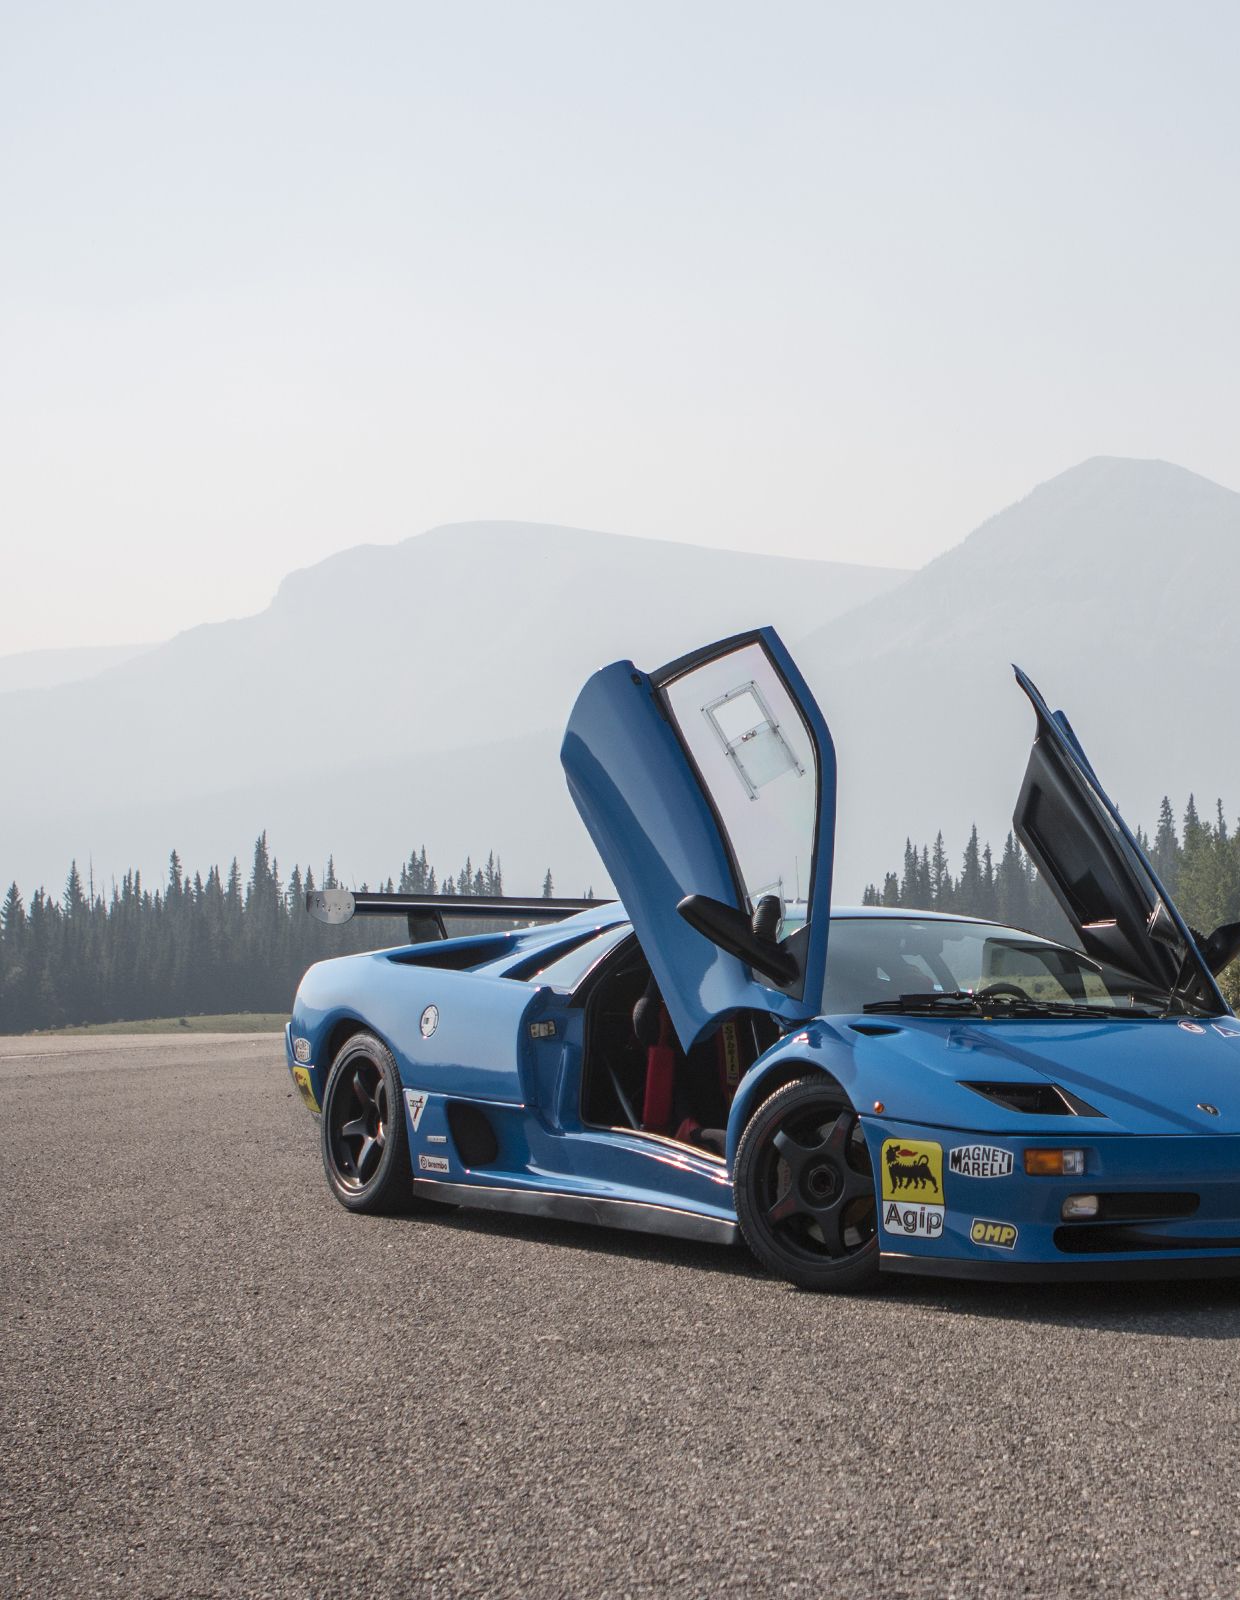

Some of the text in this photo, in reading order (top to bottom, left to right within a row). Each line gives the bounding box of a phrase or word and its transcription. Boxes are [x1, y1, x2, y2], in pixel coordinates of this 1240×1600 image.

[951, 1146, 1012, 1164] MAGNETI
[428, 1159, 448, 1170] brembo
[951, 1161, 1012, 1176] MARELLI
[885, 1203, 942, 1234] Agip
[972, 1223, 1015, 1243] OMP
